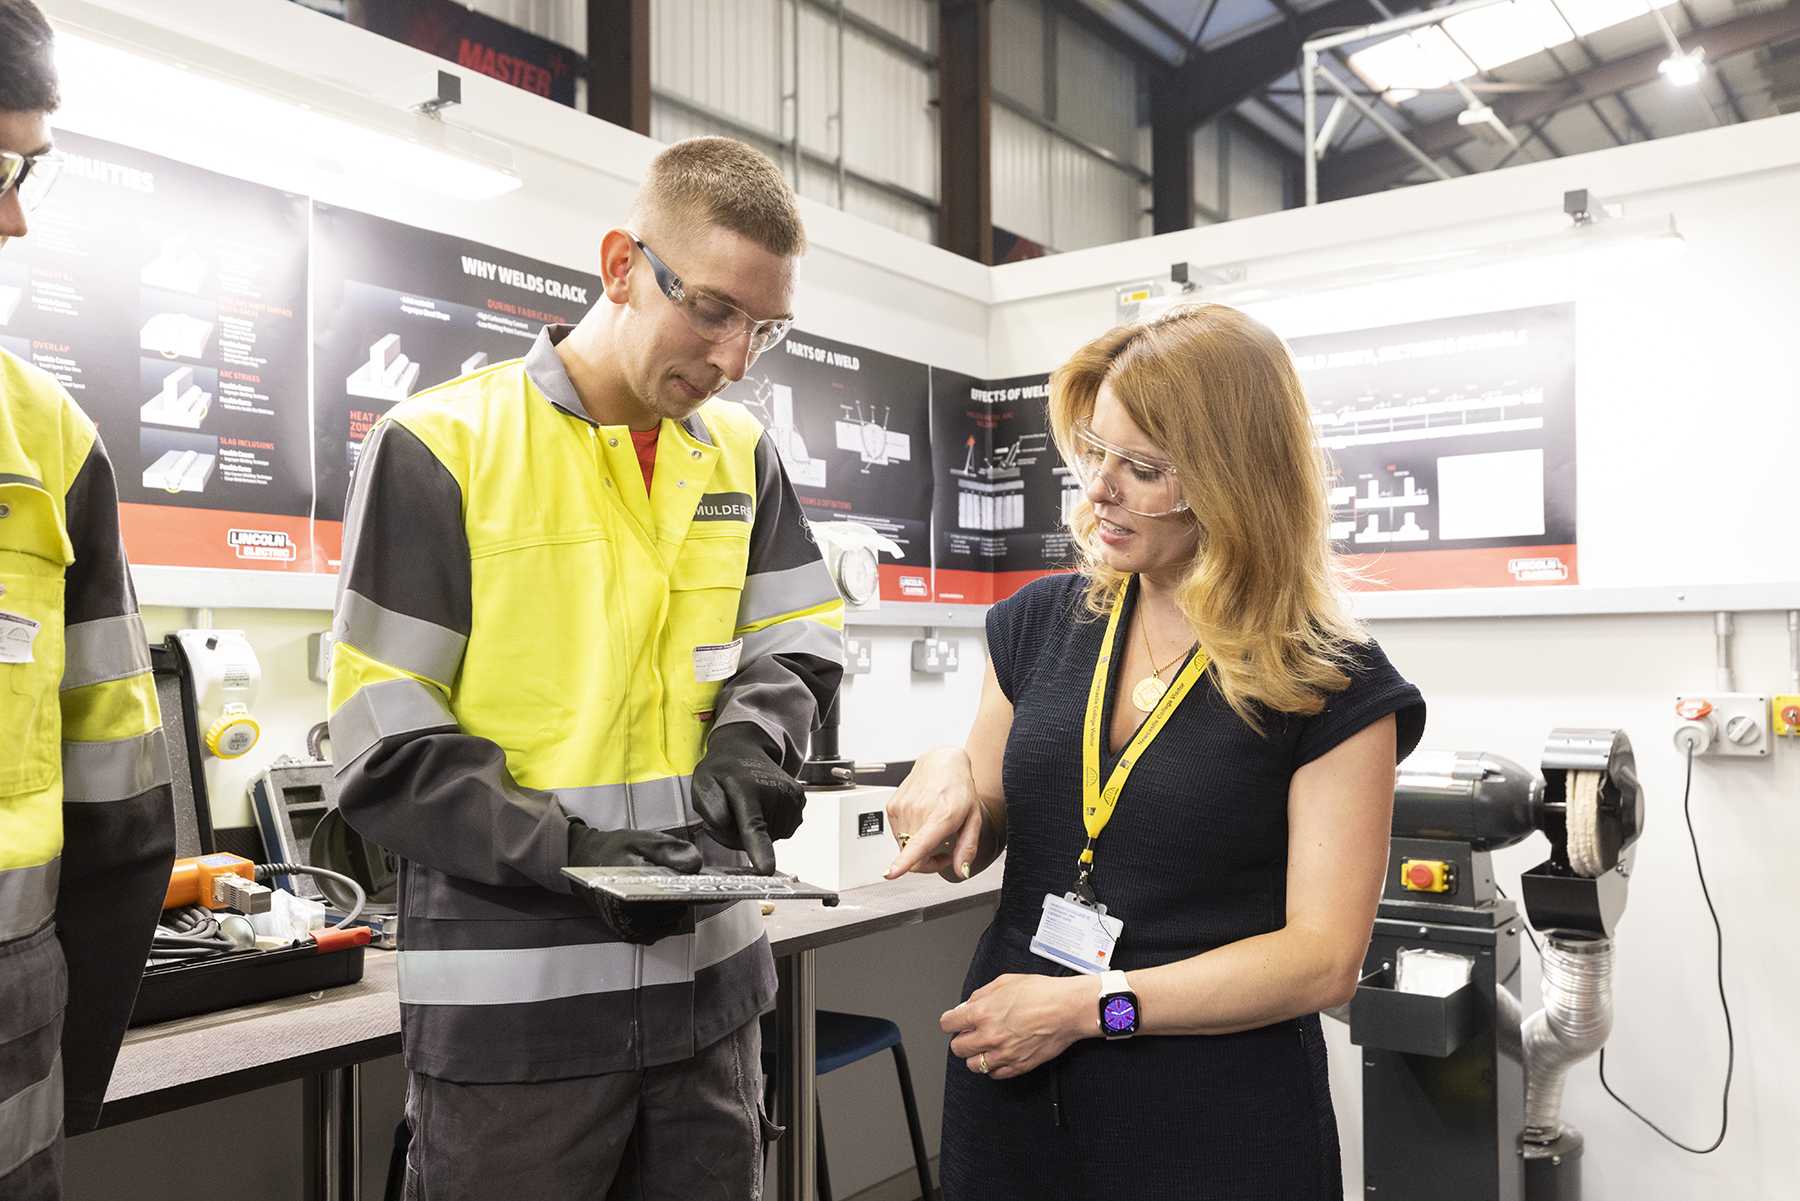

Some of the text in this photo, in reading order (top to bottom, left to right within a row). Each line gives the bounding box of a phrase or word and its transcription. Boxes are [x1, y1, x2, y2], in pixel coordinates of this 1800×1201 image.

[458, 38, 552, 98] MASTER
[461, 255, 587, 304] WHY WELDS CRACK
[487, 299, 516, 316] DURING
[786, 340, 860, 371] PARTS OF A WELD
[971, 387, 1007, 403] EFFECTS
[1007, 387, 1021, 401] OF
[350, 410, 373, 423] HEAT
[231, 532, 286, 547] LINCOLN
